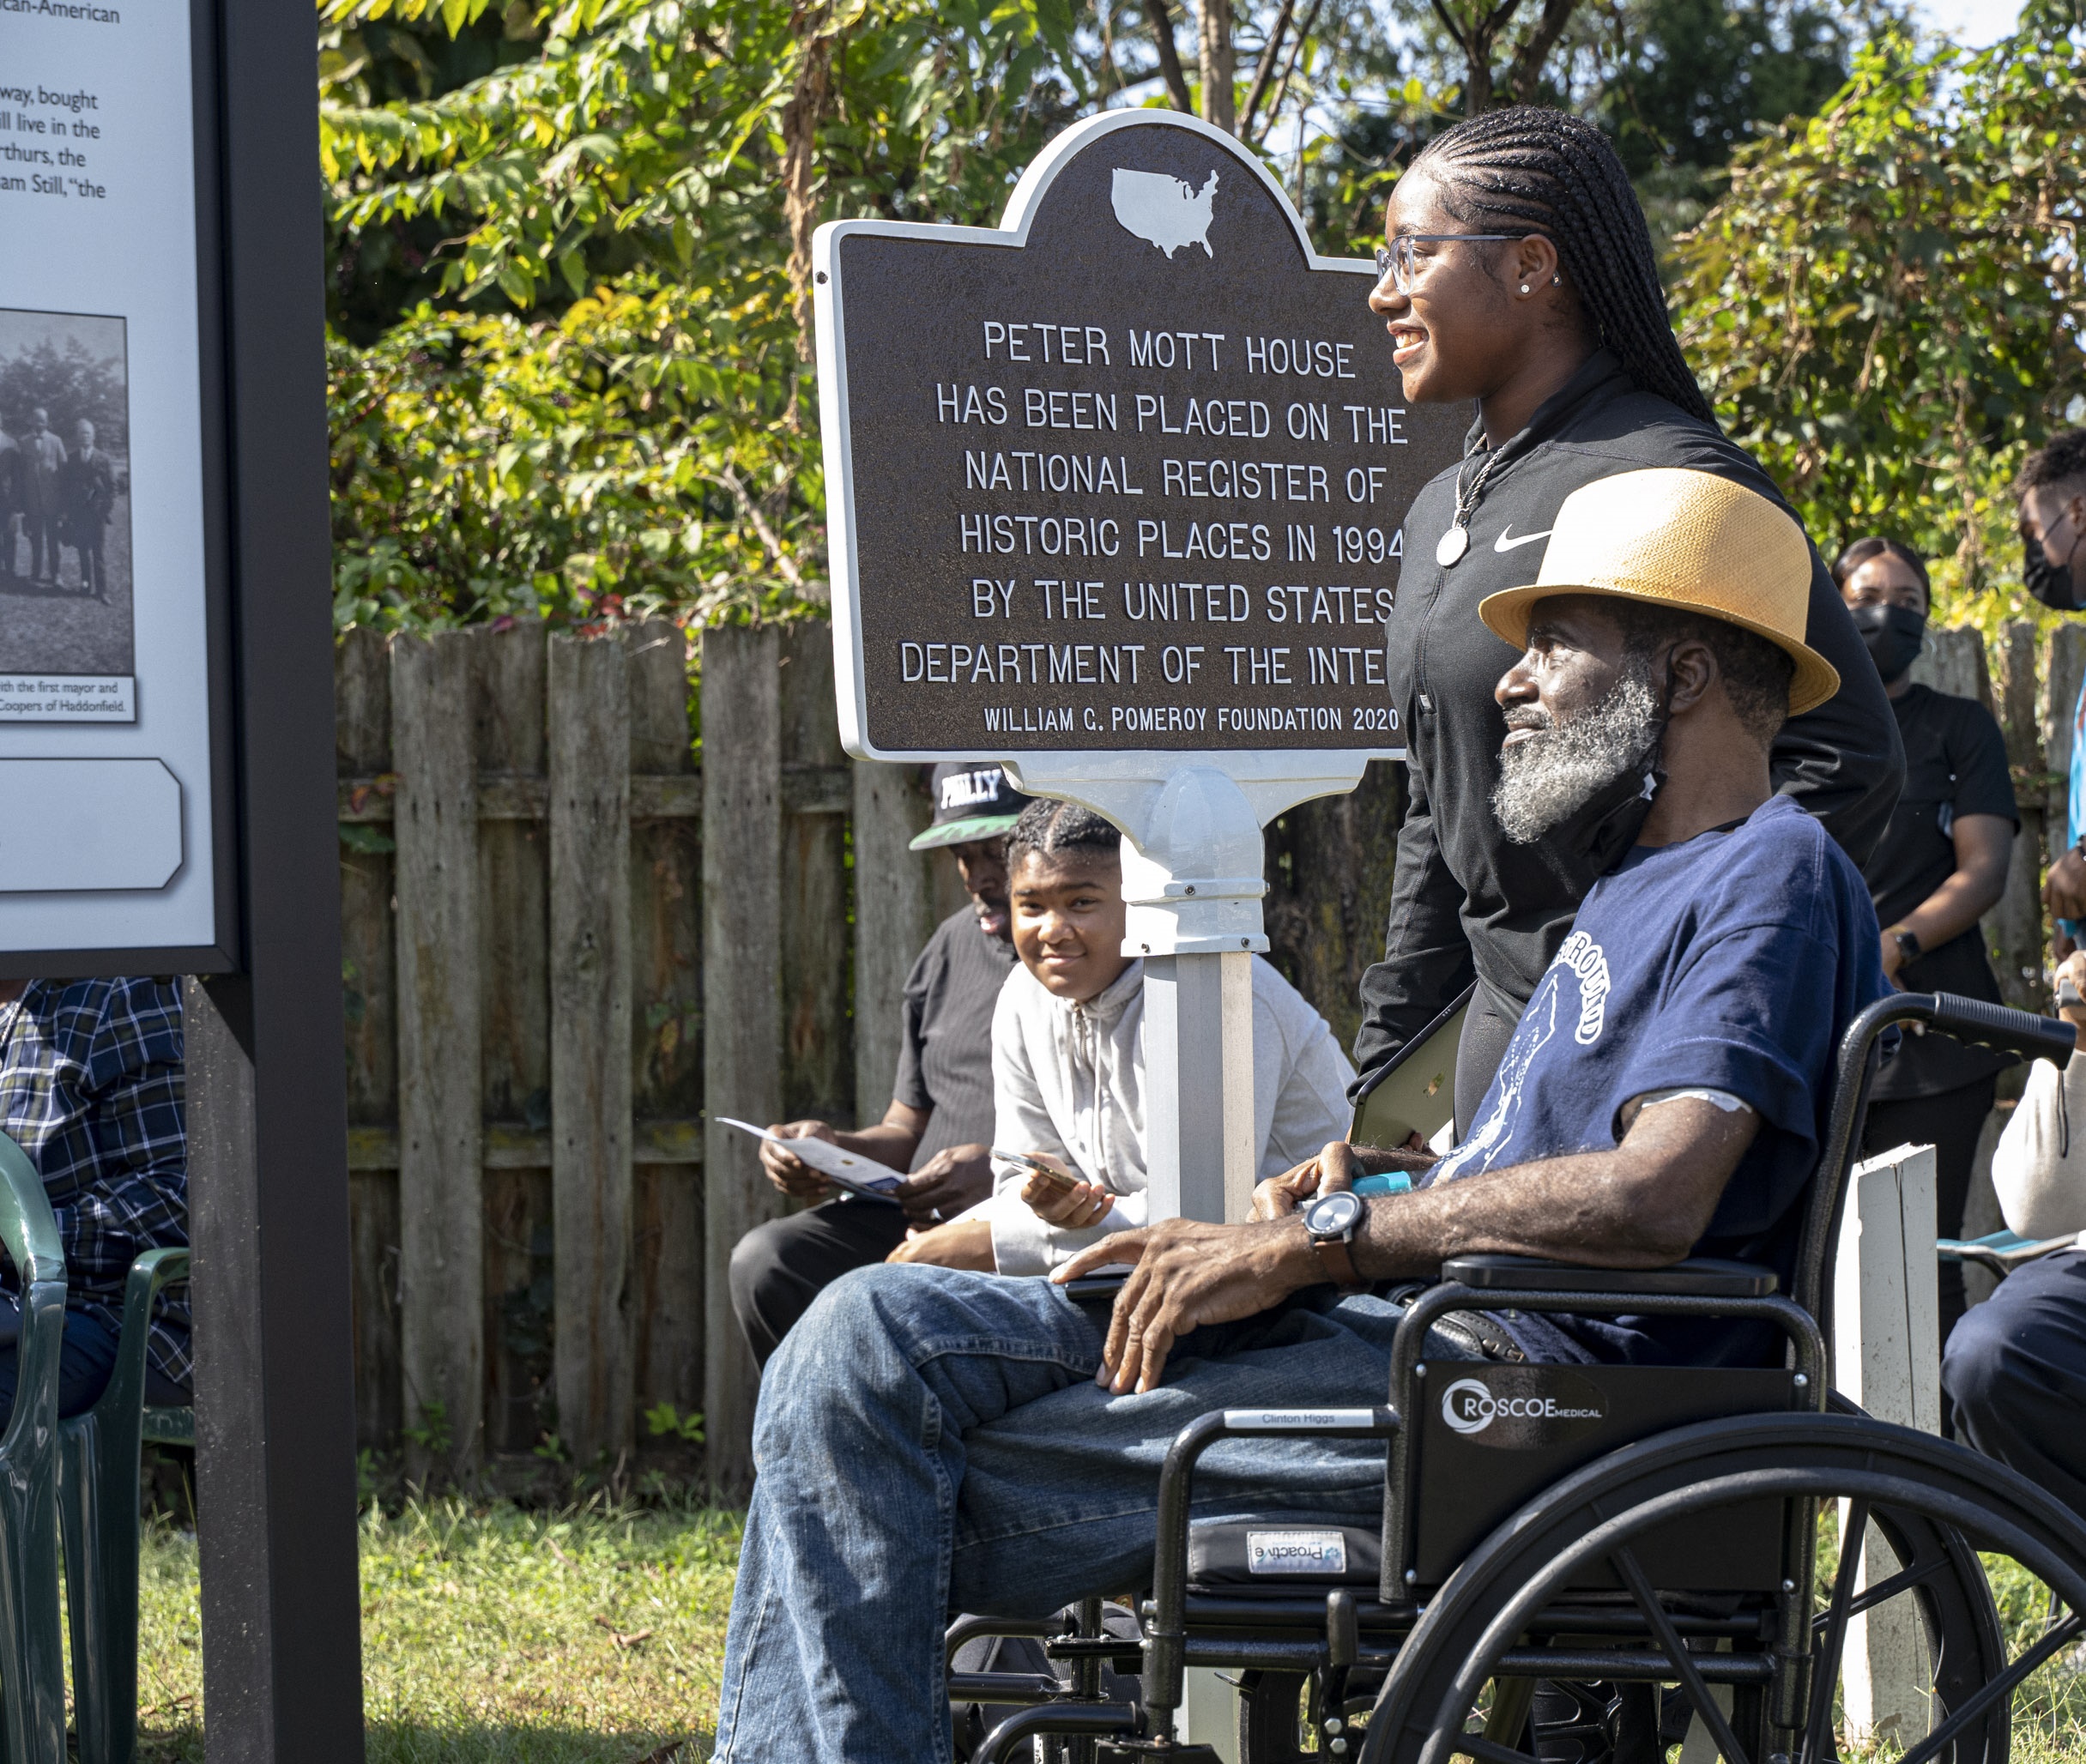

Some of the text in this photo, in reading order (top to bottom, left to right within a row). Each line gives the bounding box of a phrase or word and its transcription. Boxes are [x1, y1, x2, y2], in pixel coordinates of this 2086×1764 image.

[0, 0, 120, 24] can-American
[38, 86, 99, 113] bought
[17, 112, 46, 134] live
[51, 118, 67, 136] in
[72, 119, 101, 139] the
[58, 148, 86, 167] the
[32, 173, 68, 198] Still,
[984, 322, 1355, 378] PETER MOTT HOUSE
[937, 384, 1407, 444] HAS BEEN PLACED ON THE
[966, 450, 1387, 503] NATIONAL REGISTER OF
[961, 515, 1403, 565] HISTORIC PLACES IN 1994
[973, 580, 1394, 624] BY THE UNITED STATES
[902, 643, 1385, 685] DEPARTMENT OF THE INTE
[17, 680, 35, 692] the
[38, 680, 59, 693] first
[63, 685, 96, 696] mayor
[100, 682, 118, 693] and
[45, 699, 57, 711] of
[60, 700, 127, 713] Haddonfield.
[984, 707, 1399, 731] WILLIAM G. POMEROY FOUNDATION 2020
[1262, 1413, 1335, 1424] Clinton Higgs
[1464, 1398, 1602, 1418] ROSCOE MEDICAL
[1255, 1546, 1323, 1562] Proactive
